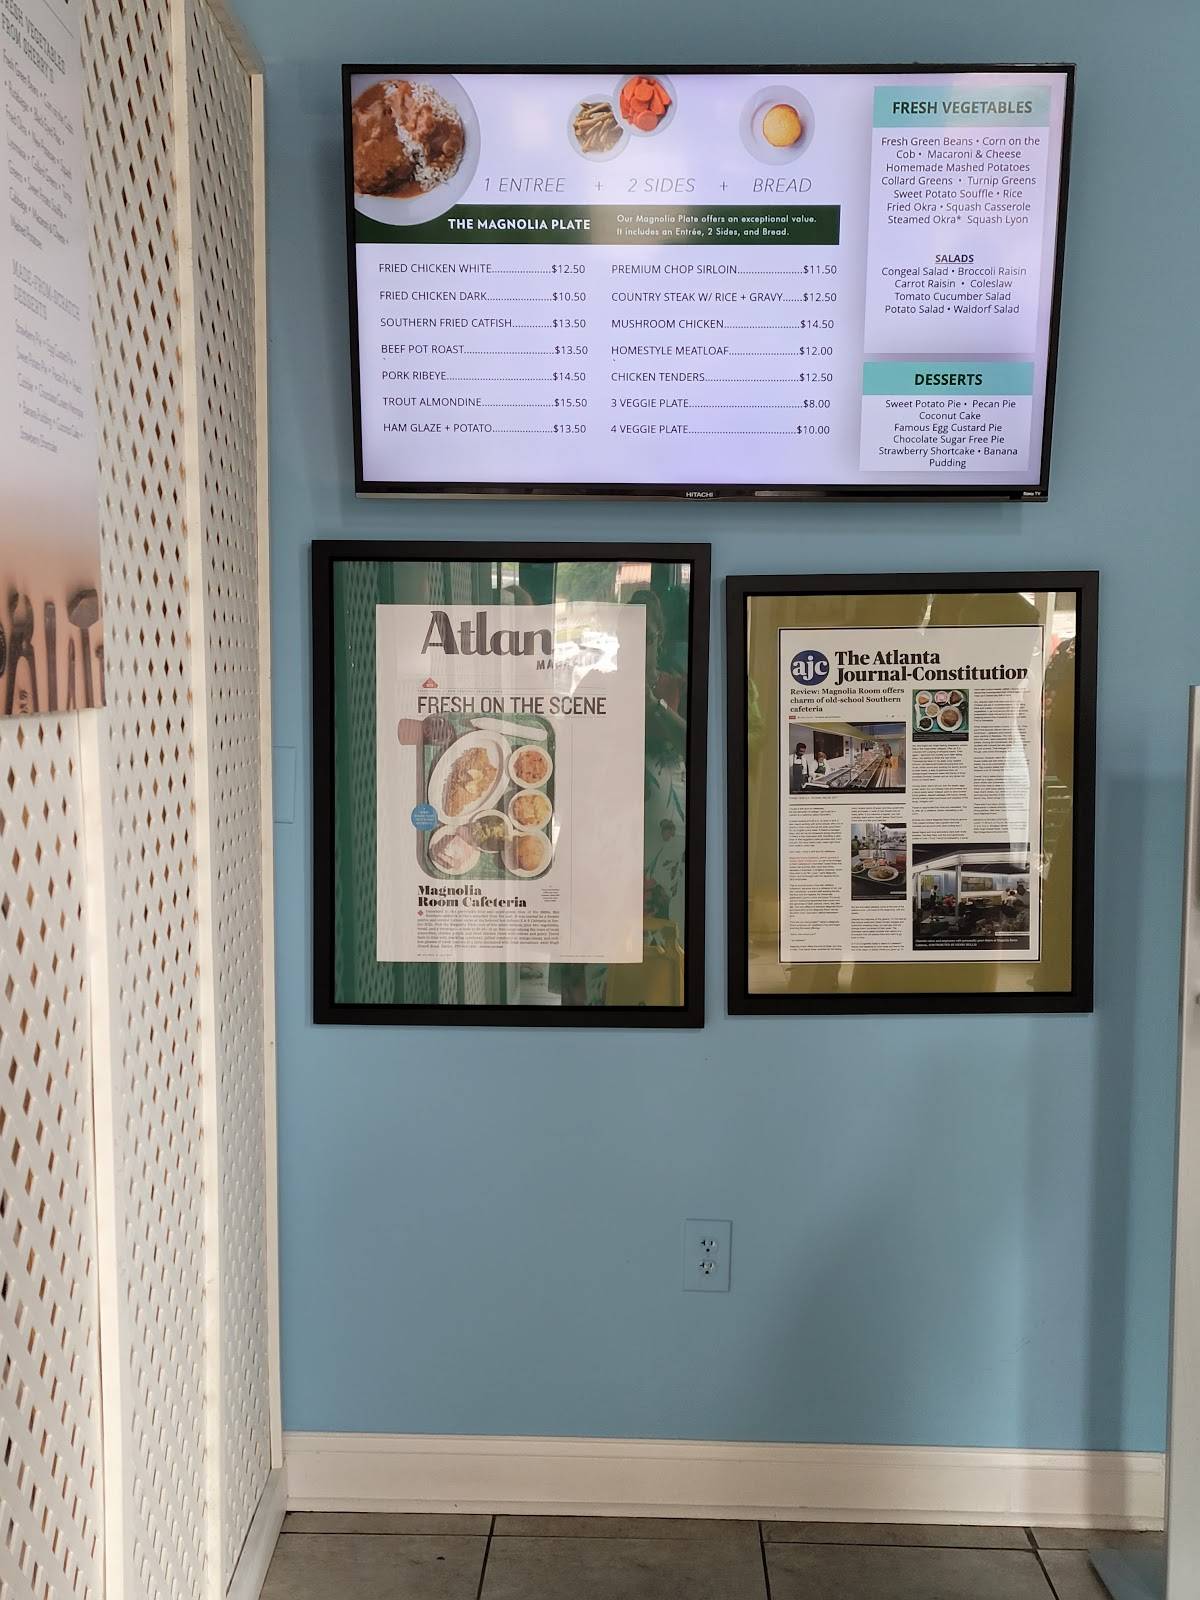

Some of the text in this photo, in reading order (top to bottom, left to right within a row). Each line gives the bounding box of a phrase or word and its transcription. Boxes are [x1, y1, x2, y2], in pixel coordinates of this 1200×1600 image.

[892, 101, 1032, 114] FRESH VEGETABLES
[881, 137, 908, 146] Fresh
[911, 138, 940, 146] Green
[944, 137, 973, 145] Beans
[982, 137, 1005, 145] Corn
[1025, 137, 1040, 145] the
[897, 150, 1021, 158] Cob Macaroni Cheese
[886, 163, 1030, 172] Homemade Mashed Potatoes
[485, 178, 566, 192] 1 ENTREE
[628, 178, 696, 192] 2 SIDES
[753, 178, 812, 192] BREAD
[882, 176, 1036, 187] Collard Greens Turnip Greens
[894, 189, 1022, 198] Sweet Potato Souffle Rice
[887, 202, 1030, 212] Fried Okra Squash Casserole
[448, 218, 591, 230] THE MAGNOLIA PLATE
[617, 214, 633, 223] Our
[636, 214, 675, 224] Magnolia
[678, 214, 699, 223] Plate
[702, 214, 725, 223] offers
[742, 214, 789, 224] exceptional
[792, 214, 817, 223] value.
[888, 216, 930, 224] Steamed
[968, 215, 1002, 226] Squash
[1006, 215, 1028, 225] Lyon
[935, 254, 974, 264] SALADS
[379, 264, 585, 274] FRIED CHICKEN WHITE $12.50
[612, 265, 837, 275] PREMIUM CHOP SIRLOIN $11.50
[882, 267, 1026, 278] Congeal Salad Broccoli Raisin
[895, 279, 1012, 288] Carrot Raisin Coleslaw
[380, 291, 586, 302] FRIED CHICKEN DARK $10.50
[612, 293, 837, 302] COUNTRY STEAK RICE GRAVY $12.50
[895, 292, 1011, 301] Tomato Cucumber Salad
[885, 305, 1019, 313] Potato Salad Waldorf Salad
[381, 318, 586, 329] SOUTHERN FRIED CATFISH $13.50
[612, 320, 834, 329] MUSHROOM CHICKEN $14.50
[381, 345, 588, 355] BEEF POT ROAST $13.50
[612, 346, 833, 356] HOMESTYLE MEATLOAF $12.00
[382, 371, 586, 381] PORK RIBEYE $14.50
[611, 372, 833, 382] CHICKEN TENDERS $12.50
[915, 374, 982, 385] DESSERTS
[383, 397, 587, 408] TROUT ALMONDINE $15.50
[620, 399, 830, 409] VEGGIE PLATE $8.00
[886, 400, 1016, 408] Sweet Potato Pie Pecan Pie
[920, 412, 981, 420] Coconut Cake
[383, 424, 587, 434] HAM GLAZE POTATO $13.50
[620, 425, 830, 435] VEGGIE PLATE $10.00
[895, 424, 929, 432] Famous
[933, 424, 948, 433] Egg
[893, 435, 938, 443] Chocolate
[941, 436, 966, 445] Sugar
[991, 435, 1004, 443] Pie
[879, 447, 1018, 457] Strawberry Shortcake Banana
[930, 459, 966, 468] Pudding
[421, 610, 555, 656] Atlan
[835, 650, 940, 665] The Atlanta
[793, 655, 828, 680] ajc
[835, 664, 1028, 685] Journal-Constitution
[418, 697, 607, 715] FRESH ON THE SCENE
[418, 885, 482, 897] Magnolia
[418, 897, 527, 908] Room Cafeteria
